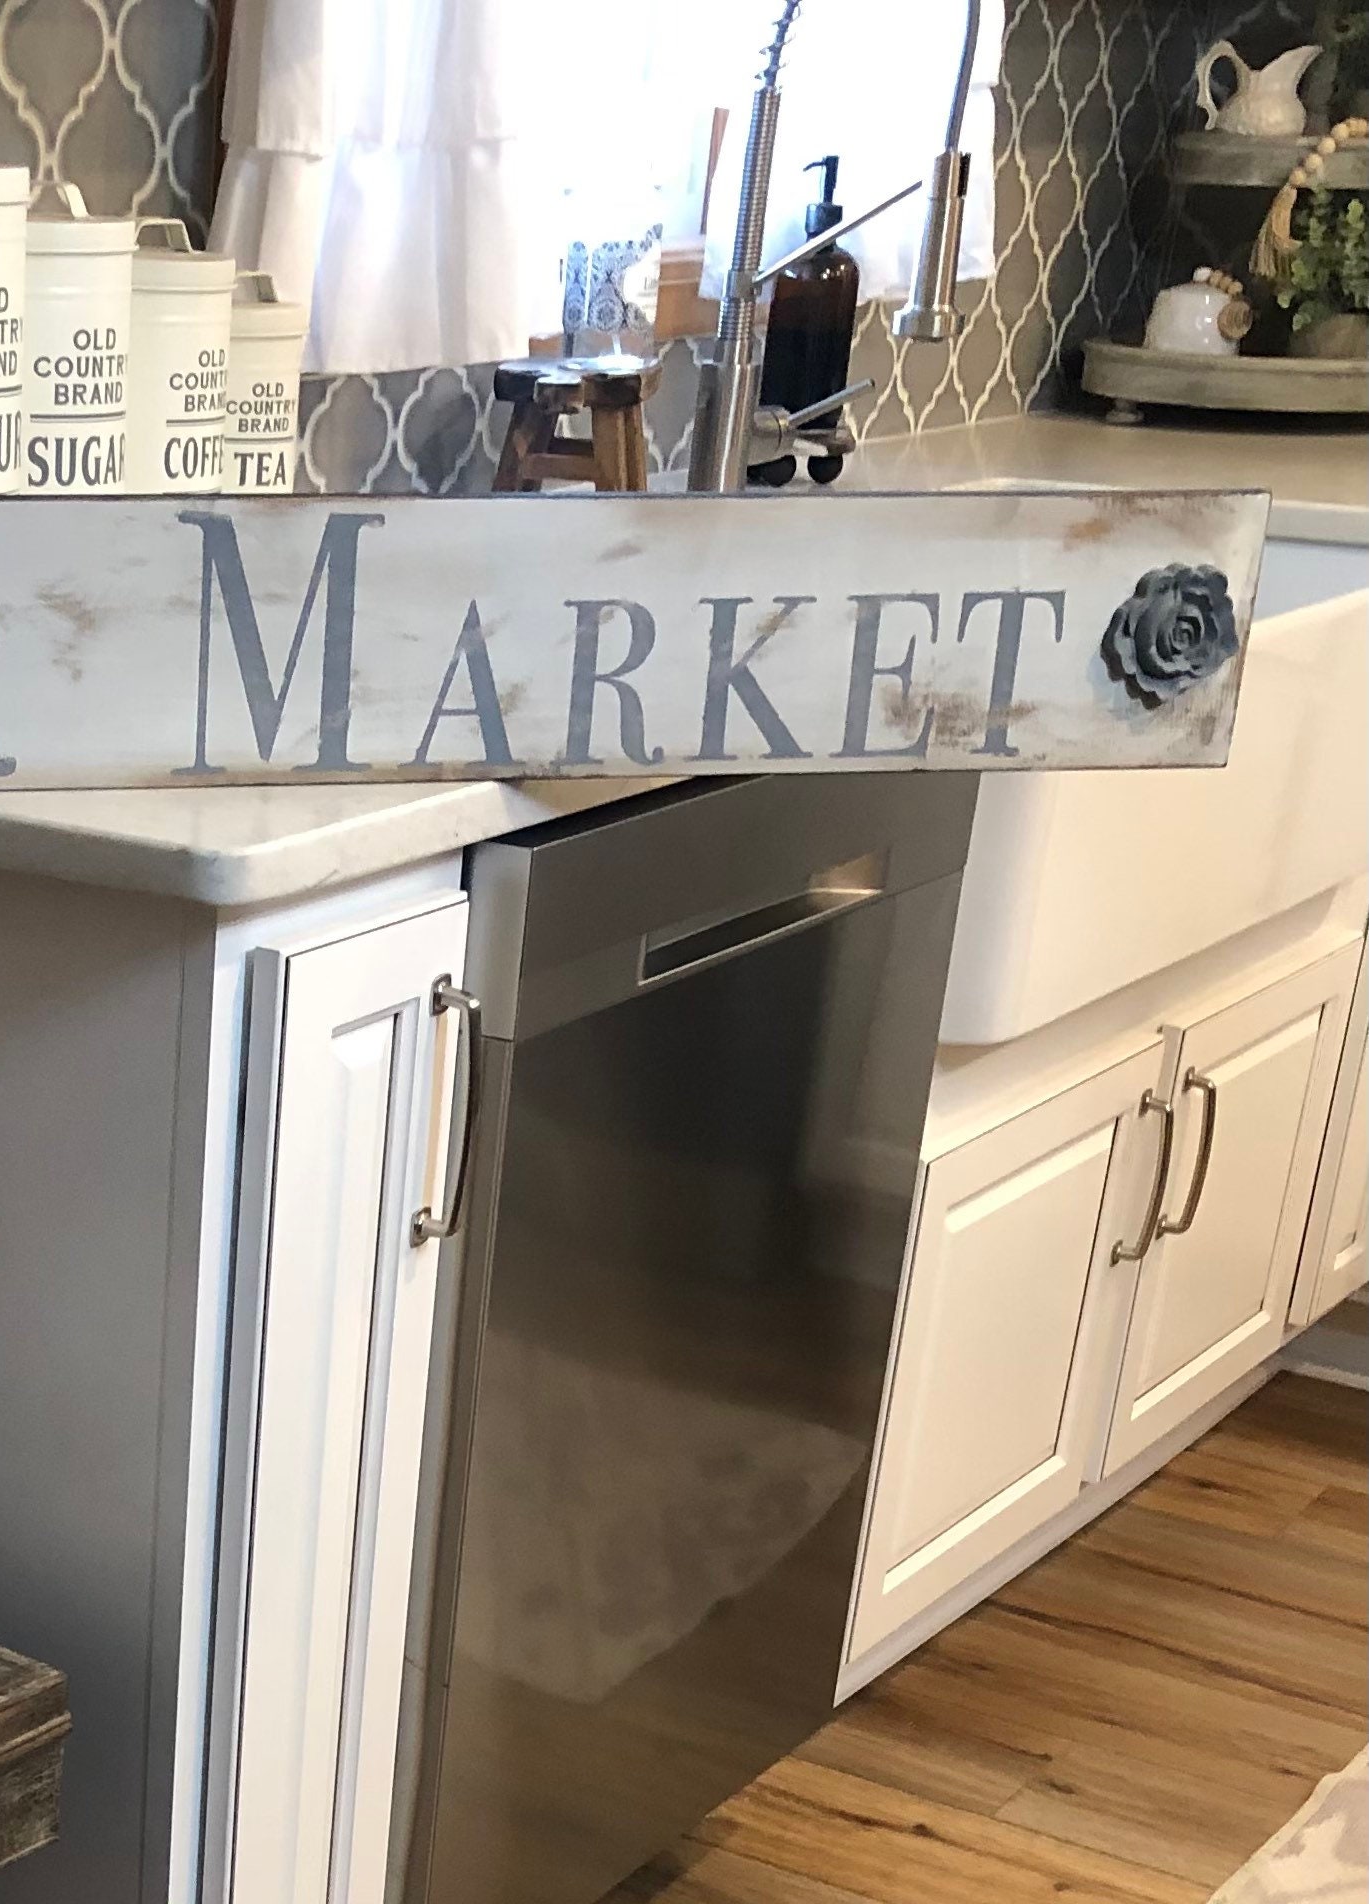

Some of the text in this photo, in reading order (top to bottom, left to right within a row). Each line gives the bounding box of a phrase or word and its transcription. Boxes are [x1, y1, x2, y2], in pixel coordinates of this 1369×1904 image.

[73, 328, 116, 350] OLD
[198, 349, 225, 367] OLD
[170, 370, 227, 390] COUNT
[252, 382, 284, 397] OLD
[54, 381, 122, 405] BRAND
[238, 417, 289, 432] BRAND
[164, 434, 224, 479] COFFE
[234, 451, 286, 486] TEA
[174, 510, 1066, 776] MARKET
